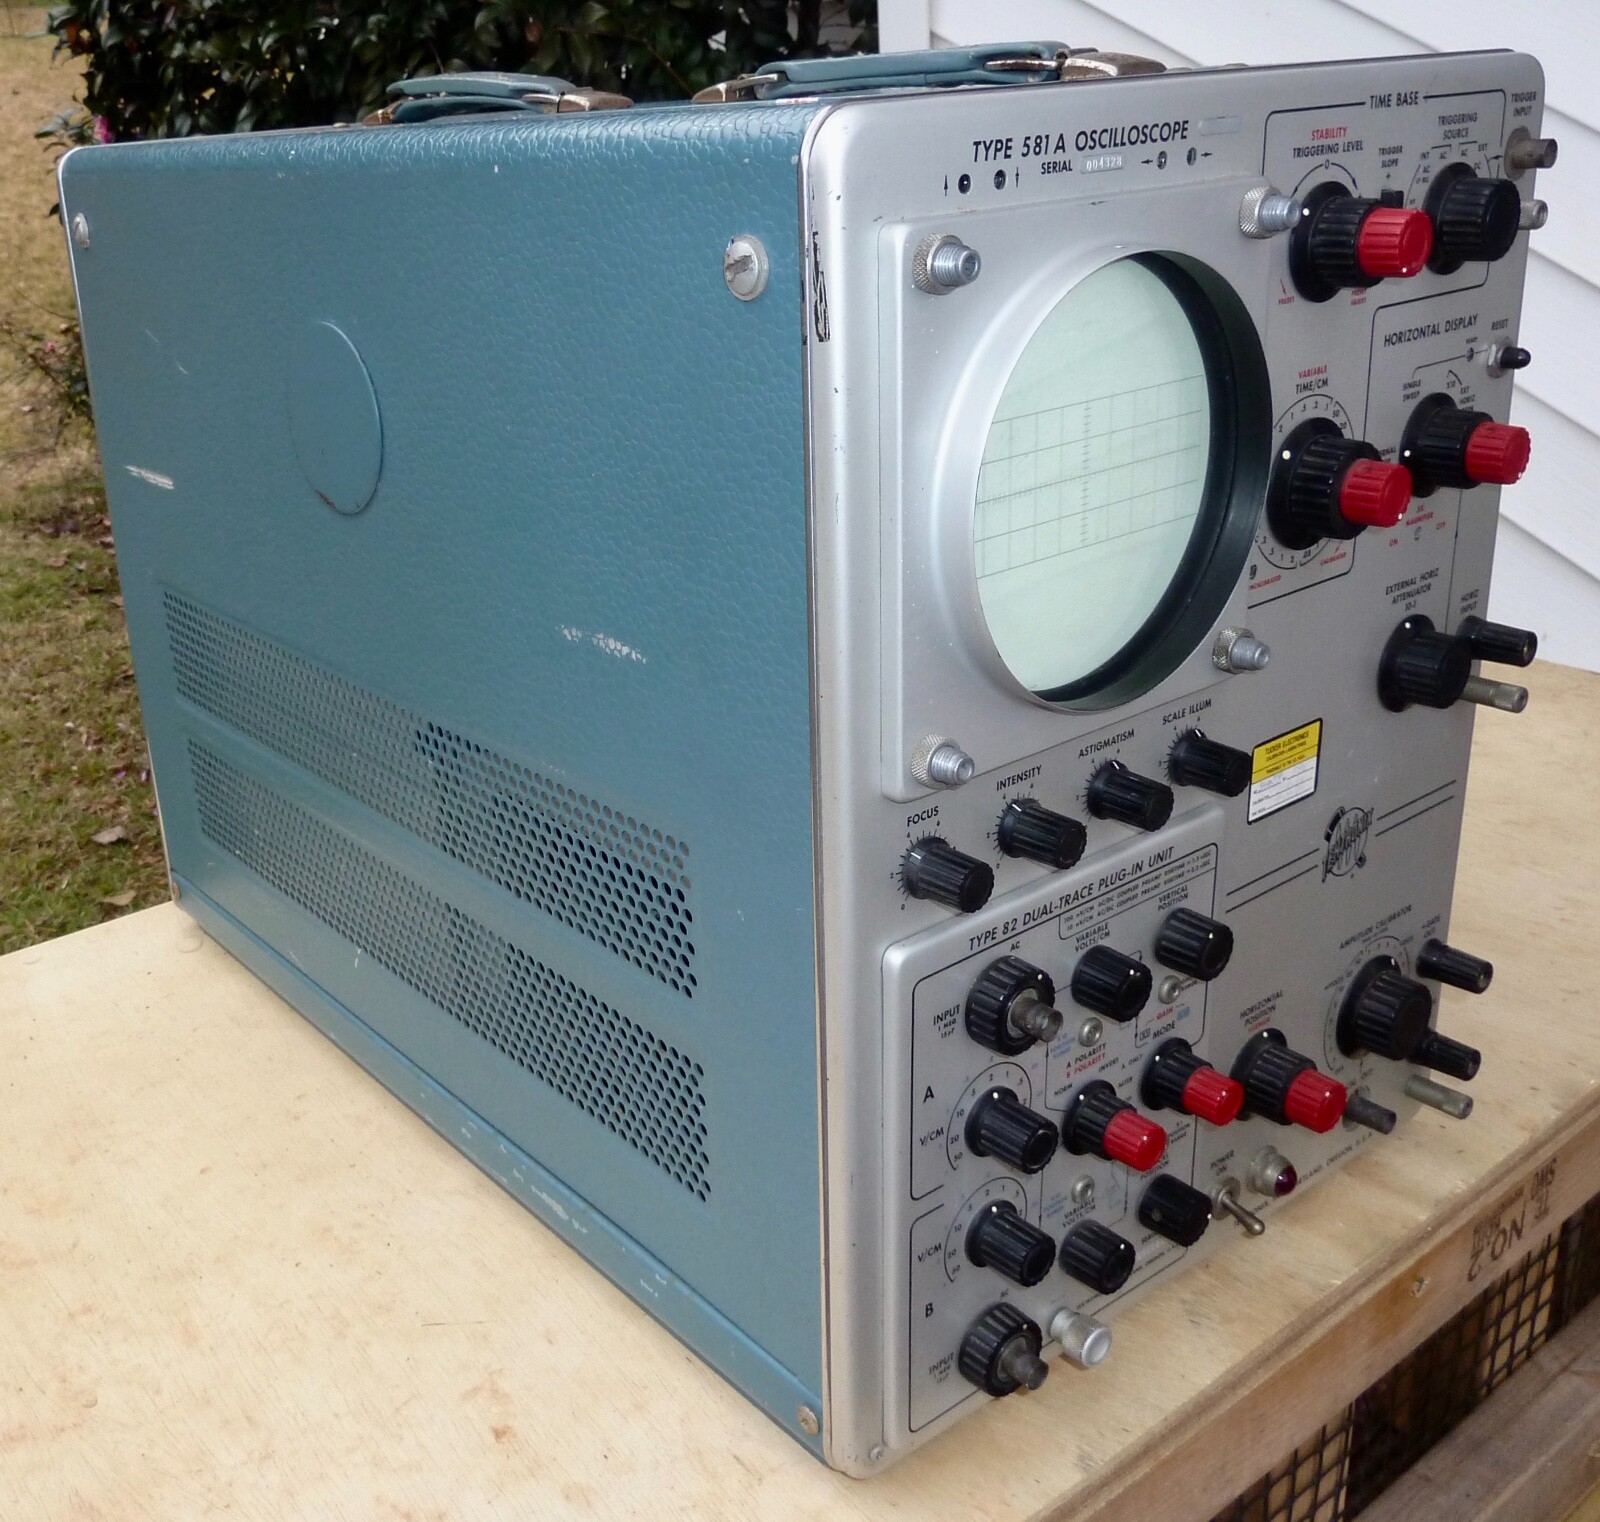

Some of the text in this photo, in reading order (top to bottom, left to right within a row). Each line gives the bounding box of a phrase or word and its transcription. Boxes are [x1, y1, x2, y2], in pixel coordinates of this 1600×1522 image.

[1370, 91, 1419, 109] TIME BASE
[1511, 91, 1537, 104] TRIGGER
[1438, 112, 1478, 127] TRIGGERING
[1513, 106, 1532, 117] INPUT
[973, 137, 1013, 163] TYPE
[1075, 120, 1189, 151] OSCILLOSCOPE
[1311, 126, 1348, 141] STABILITY
[1442, 127, 1469, 141] SOURCE
[1293, 140, 1364, 159] TRIGGERING LEVEL
[1041, 160, 1073, 175] SERIAL
[1384, 313, 1478, 347] HORIZONTAL DISPLAY
[1491, 318, 1509, 331] RESET
[1298, 364, 1328, 379] VARIABLE
[1295, 377, 1329, 394] TIME/CM
[1385, 577, 1417, 595] EXTERNAL
[1392, 583, 1432, 604] ATTENUATOR
[1162, 699, 1212, 725] SCALE ILLUM
[1078, 728, 1135, 759] ASTIGMATISM
[996, 765, 1042, 791] INTENSITY
[907, 806, 939, 827] FOCUS
[969, 846, 1175, 951] TYPE 82 DUAL-TRACE PLUG-IN UNIT
[1157, 892, 1189, 911] POSITION
[1158, 885, 1188, 903] VERTICAL
[1075, 922, 1108, 943] VARIABLE
[1075, 930, 1111, 953] VOLTS/CM
[1010, 941, 1021, 951] AC
[1240, 989, 1283, 1020] HORIZONTAL
[933, 1004, 961, 1026] INPUT
[1152, 1020, 1176, 1039] MODE
[1066, 1061, 1072, 1069] A
[1074, 1043, 1107, 1064] POLARITY
[1074, 1053, 1106, 1074] POLARITY
[923, 1085, 935, 1103] A
[1054, 1083, 1073, 1097] NORM
[919, 1126, 945, 1147] V/CM
[917, 1242, 942, 1263] V/CM
[925, 1302, 934, 1318] B
